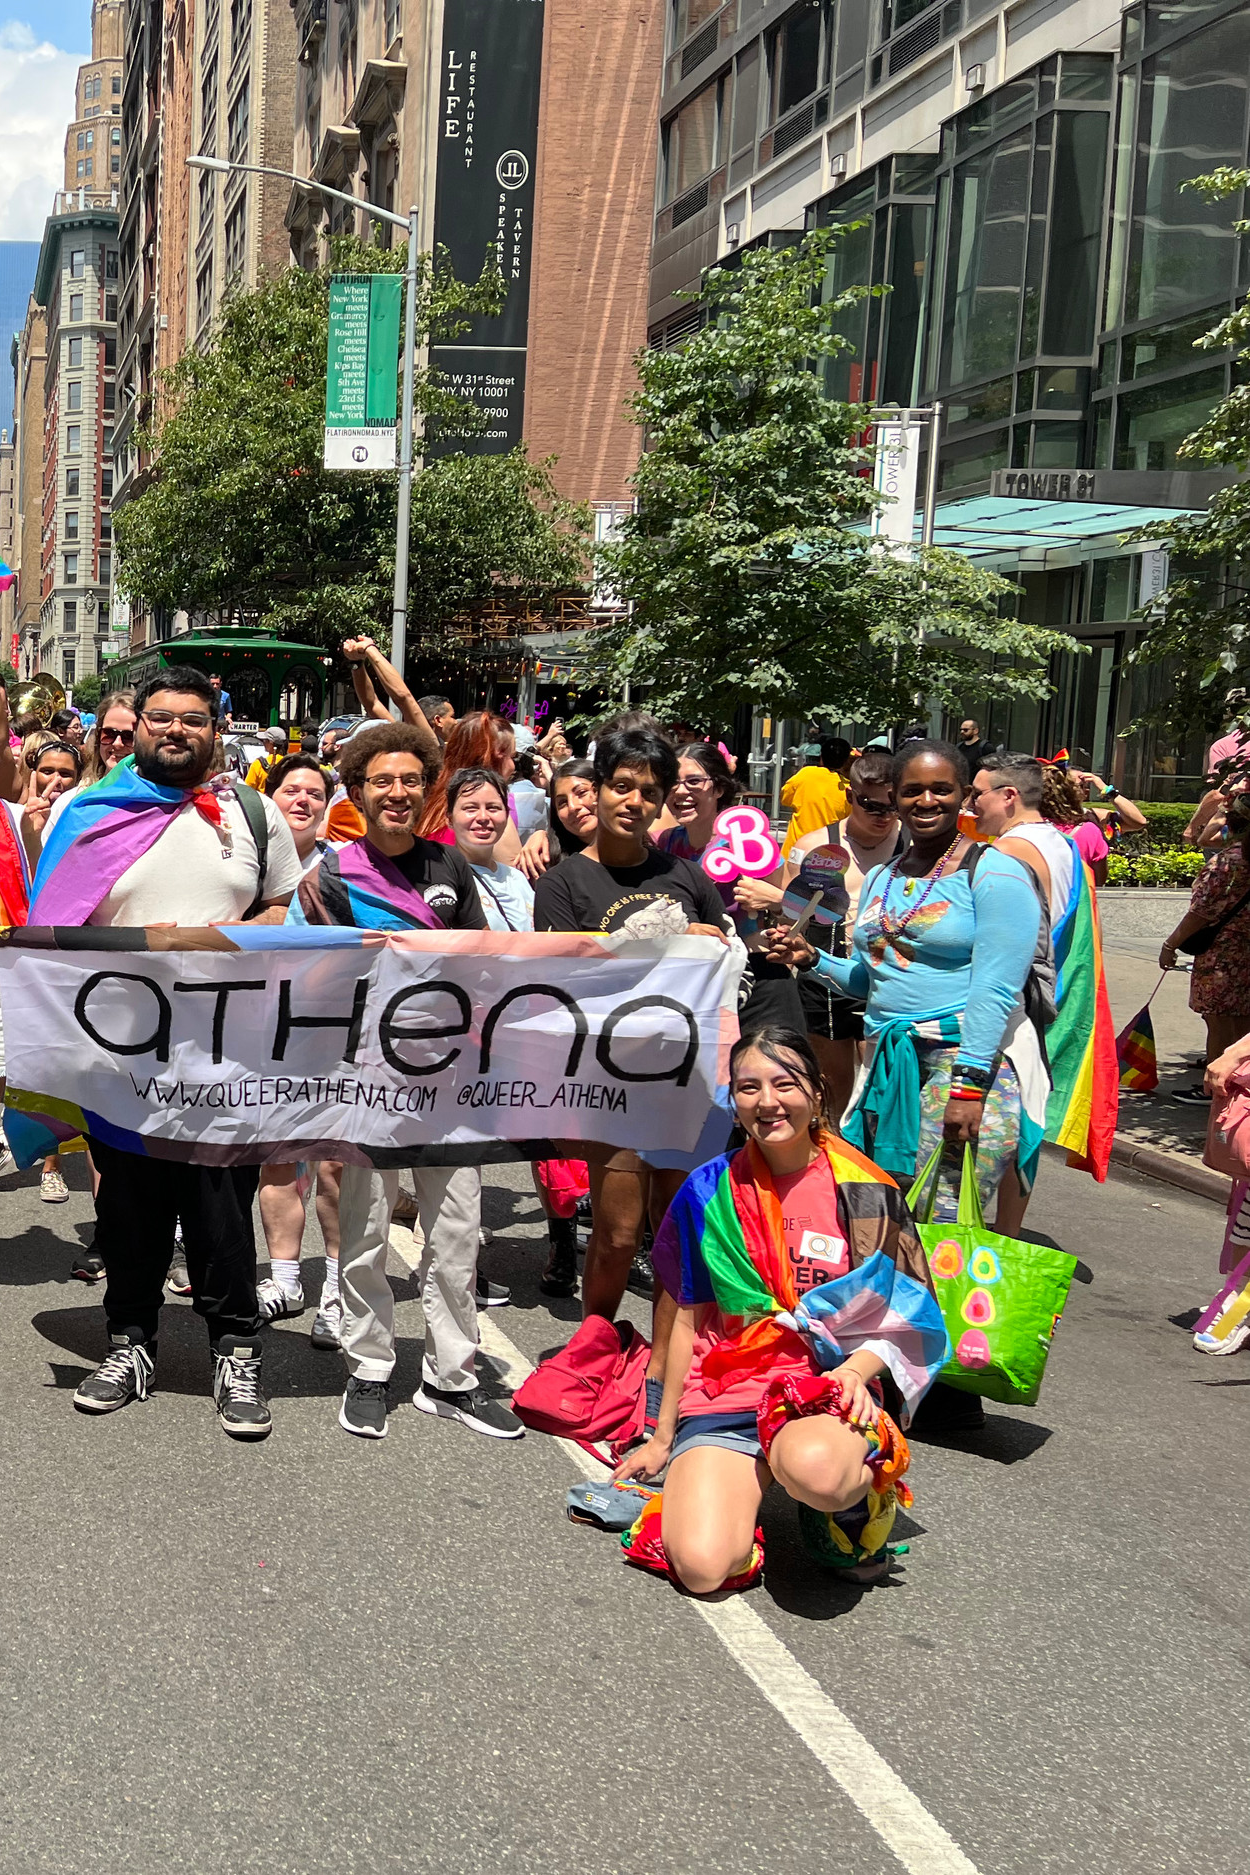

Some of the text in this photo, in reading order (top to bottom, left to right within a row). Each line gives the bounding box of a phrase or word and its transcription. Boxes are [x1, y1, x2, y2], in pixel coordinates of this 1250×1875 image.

[445, 51, 462, 137] LIFE
[465, 51, 476, 168] RESTAURANT
[495, 193, 506, 277] SPEAKEA
[512, 208, 523, 278] TAVERN
[333, 295, 368, 303] New York
[344, 286, 368, 295] Where
[331, 312, 367, 320] Gramercy
[334, 362, 365, 370] Kips Bay
[452, 374, 463, 384] W
[485, 374, 515, 385] Street
[461, 387, 476, 396] NY
[479, 387, 508, 397] 10001
[365, 418, 397, 427] NOMAD
[354, 448, 366, 460] FN
[886, 451, 900, 497] OWER
[1005, 473, 1071, 499] TOWER
[706, 808, 773, 875] B
[599, 916, 610, 931] NO
[606, 901, 624, 916] ONE
[621, 897, 630, 905] IS
[629, 893, 655, 902] FREE
[129, 1072, 627, 1114] WWW.QUEERATHENA.COM @QUEER_ATHENA
[793, 1267, 829, 1284] ER
